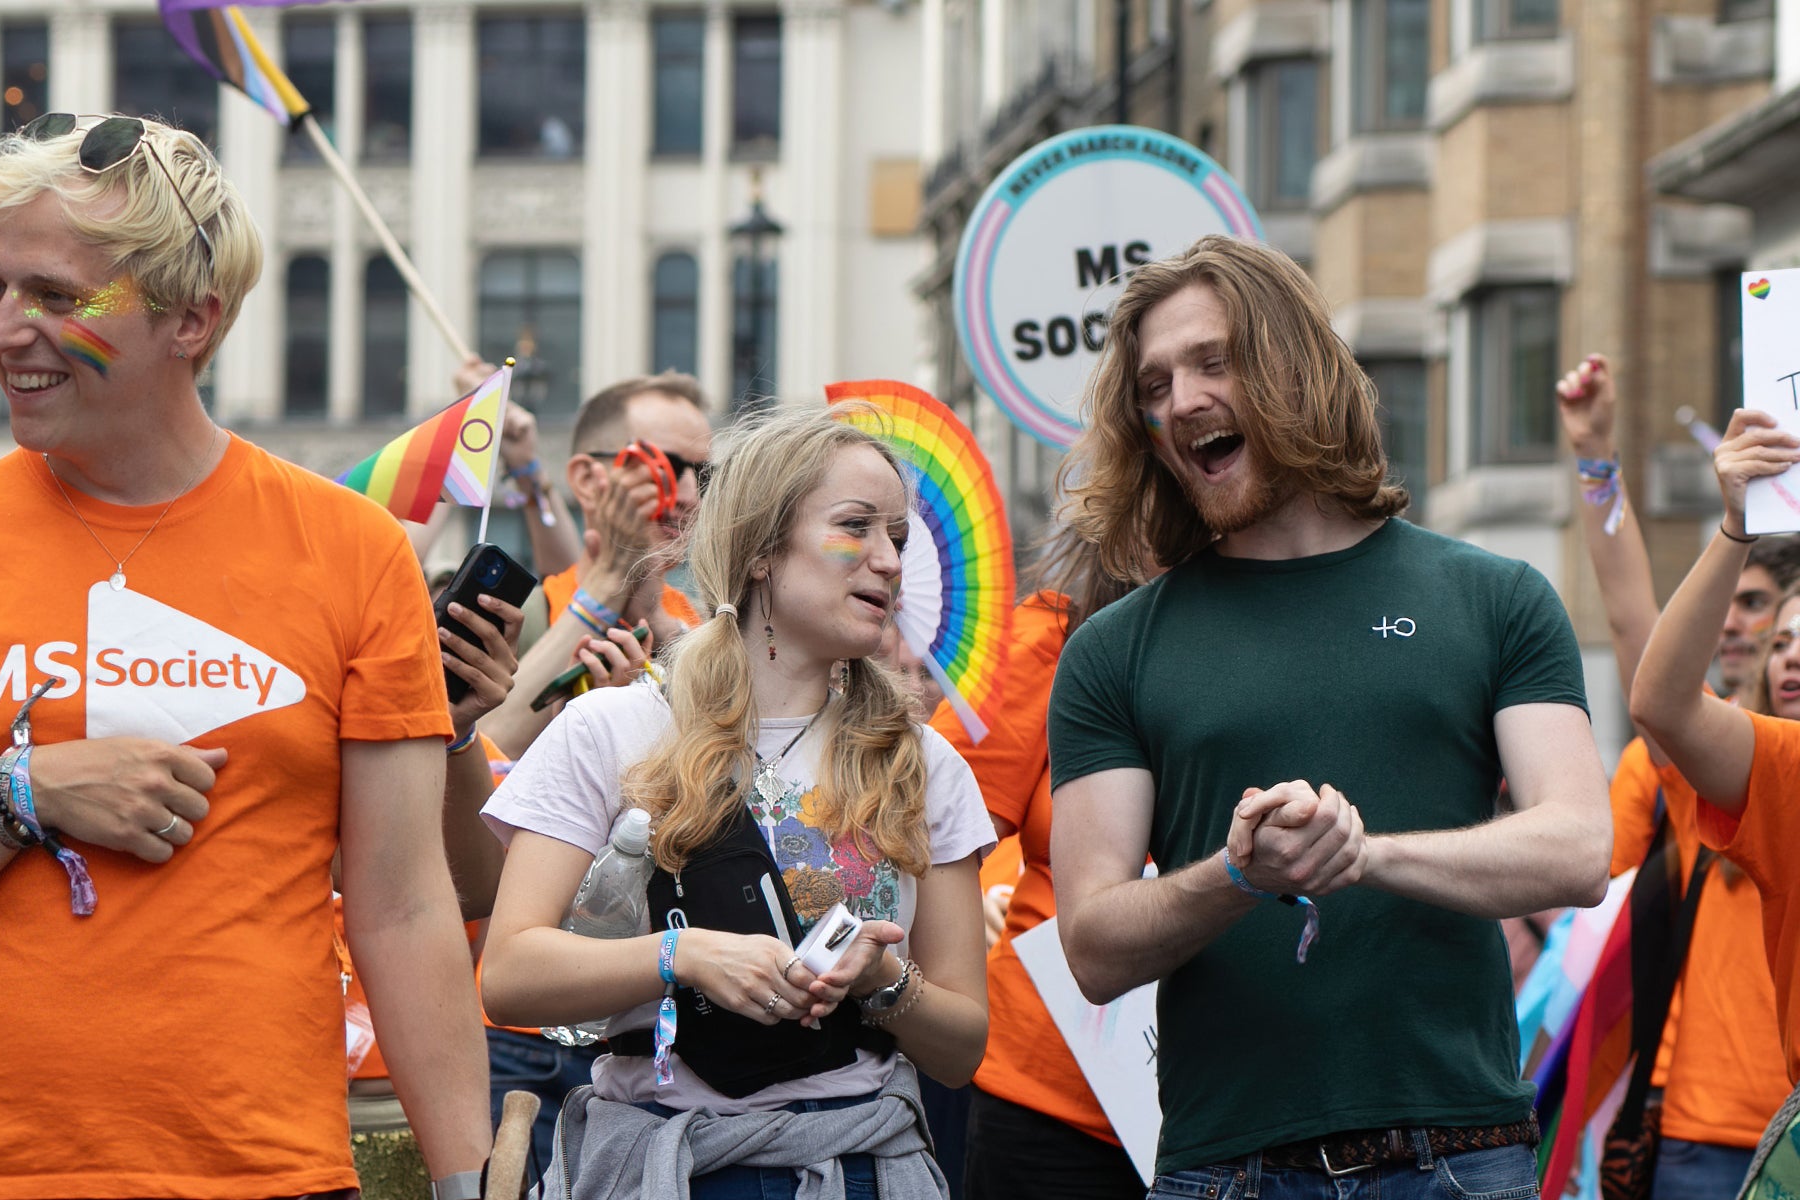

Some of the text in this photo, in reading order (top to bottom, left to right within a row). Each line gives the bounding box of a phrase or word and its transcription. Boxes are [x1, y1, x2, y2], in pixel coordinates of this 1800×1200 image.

[1009, 134, 1202, 197] NEVER MARCH ALONE
[95, 647, 278, 706] Society
[663, 937, 674, 972] PARADE
